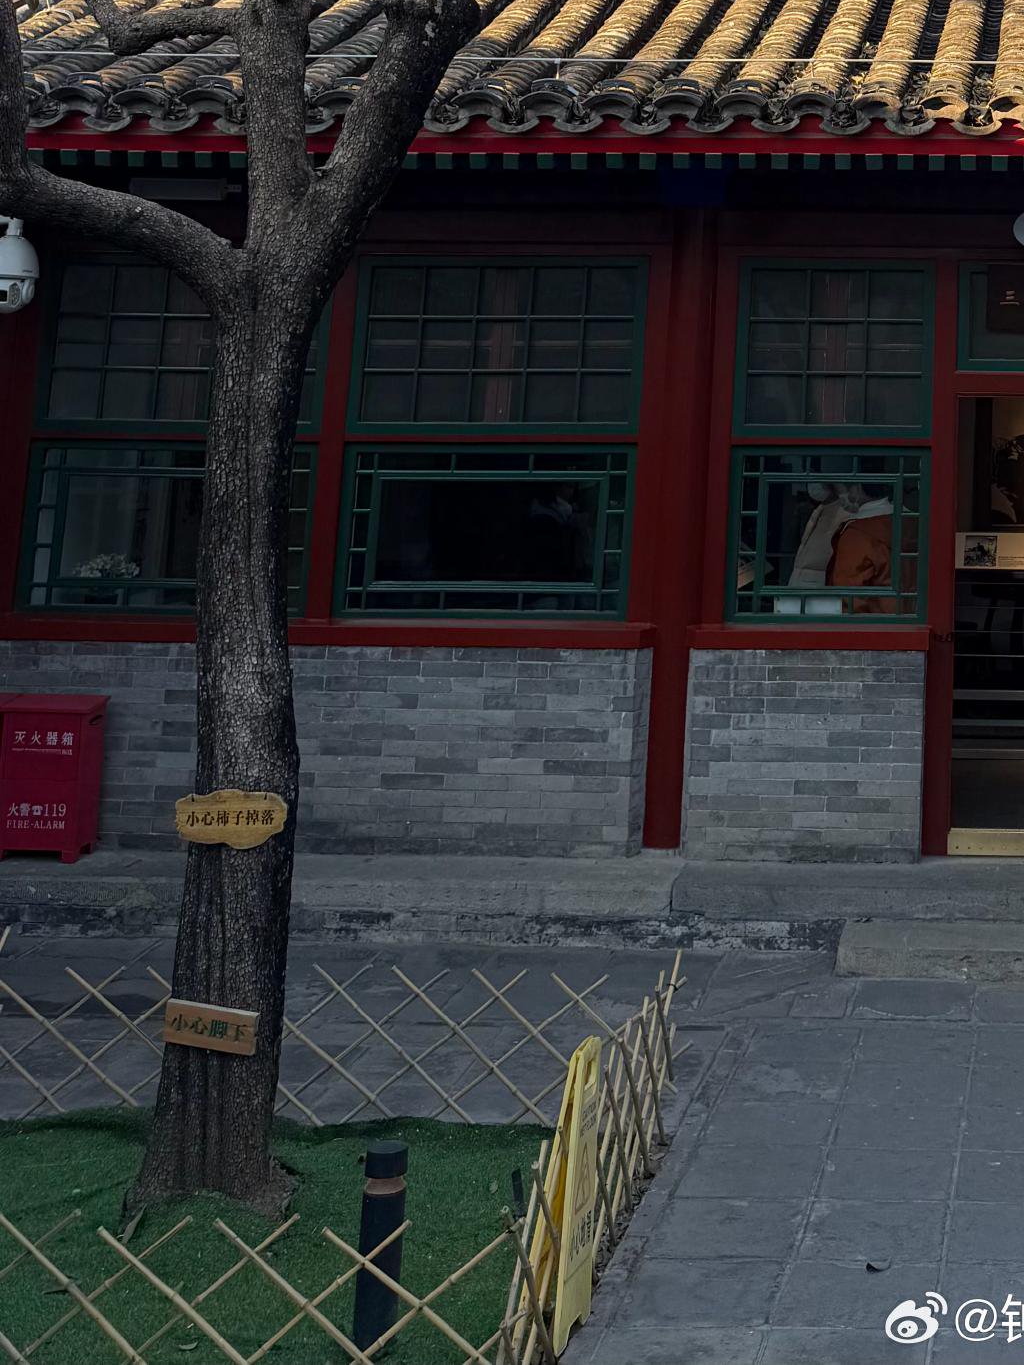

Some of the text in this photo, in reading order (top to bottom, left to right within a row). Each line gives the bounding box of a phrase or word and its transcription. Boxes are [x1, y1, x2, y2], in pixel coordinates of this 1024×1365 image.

[13, 730, 74, 746] 灭火器箱
[43, 803, 67, 817] 119
[186, 809, 275, 827] 小心柿子掉落
[6, 819, 65, 830] FIRE-ALARM
[171, 1014, 248, 1041] 小心脚下
